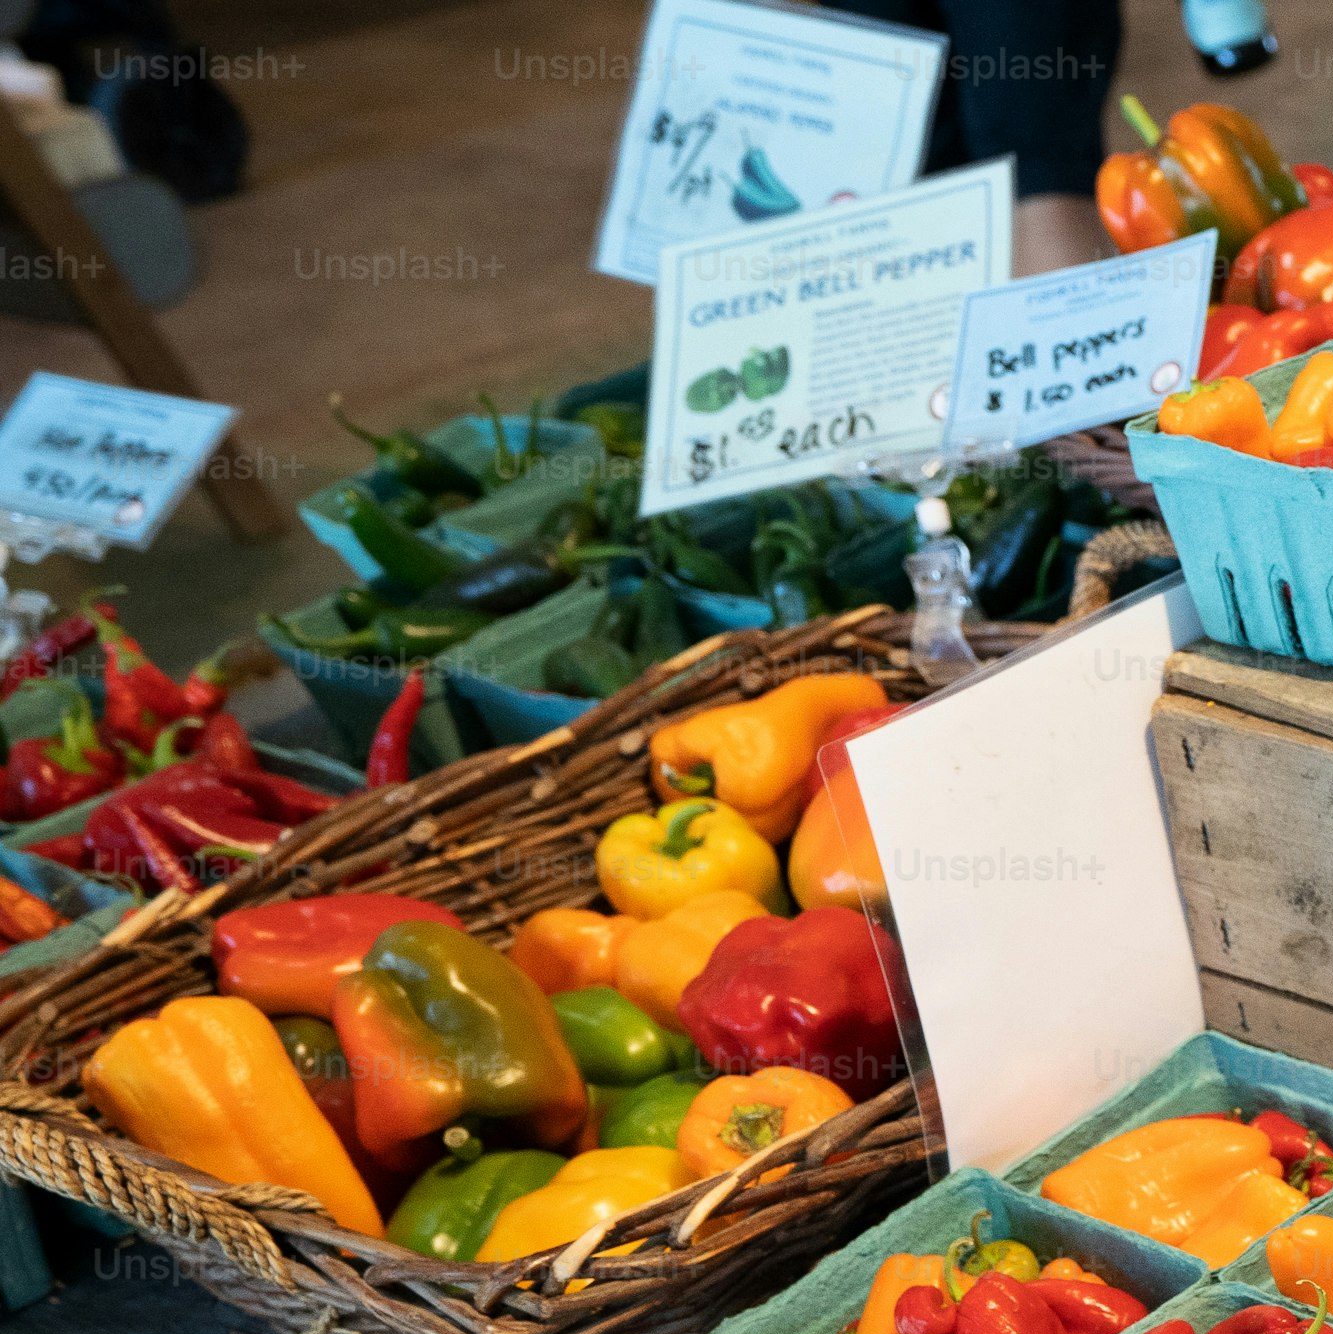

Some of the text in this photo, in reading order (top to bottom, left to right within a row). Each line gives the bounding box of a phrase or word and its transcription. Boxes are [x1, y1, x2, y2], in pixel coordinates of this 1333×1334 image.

[688, 286, 788, 329] GREEN
[798, 269, 861, 303] BELL
[874, 238, 978, 284] PEPPER
[986, 341, 1037, 380] Bell
[1051, 314, 1148, 374] peppers
[777, 404, 877, 460] each
